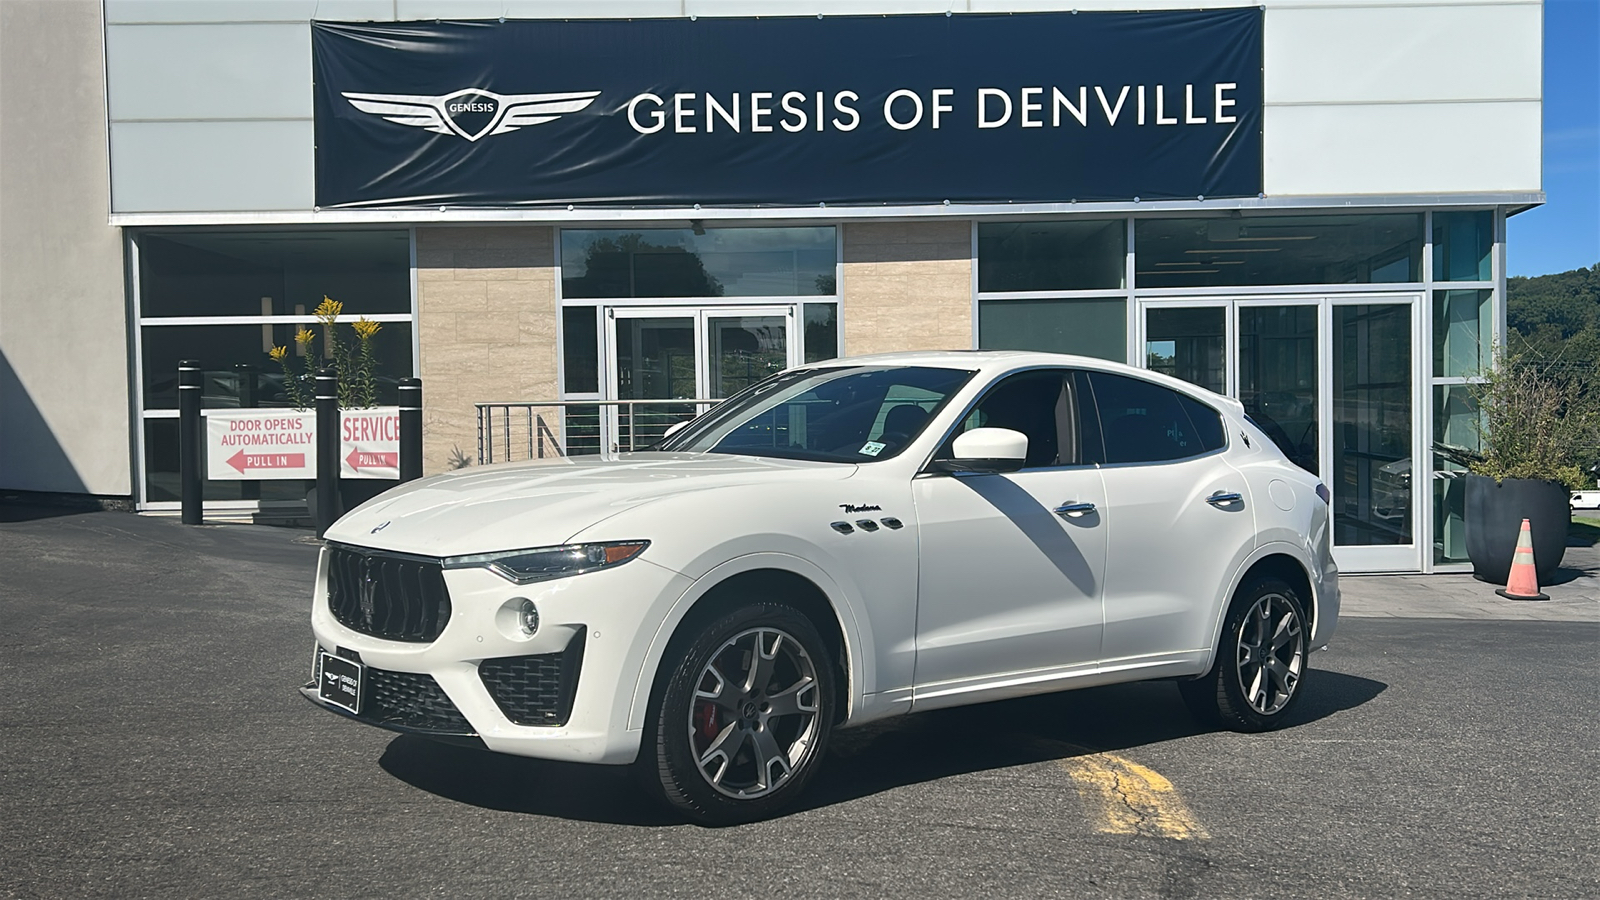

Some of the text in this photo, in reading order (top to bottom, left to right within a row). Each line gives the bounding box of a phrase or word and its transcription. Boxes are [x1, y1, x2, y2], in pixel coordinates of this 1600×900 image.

[449, 103, 494, 112] GENESIS
[626, 82, 1238, 134] GENESIS OF DENVILLE
[230, 418, 303, 432] DOOR OPENS
[343, 416, 399, 441] SERVICE
[221, 432, 313, 446] AUTOMATICALLY
[247, 455, 288, 467] PULL IN
[358, 454, 387, 465] PULL IN
[839, 503, 882, 514] Modena
